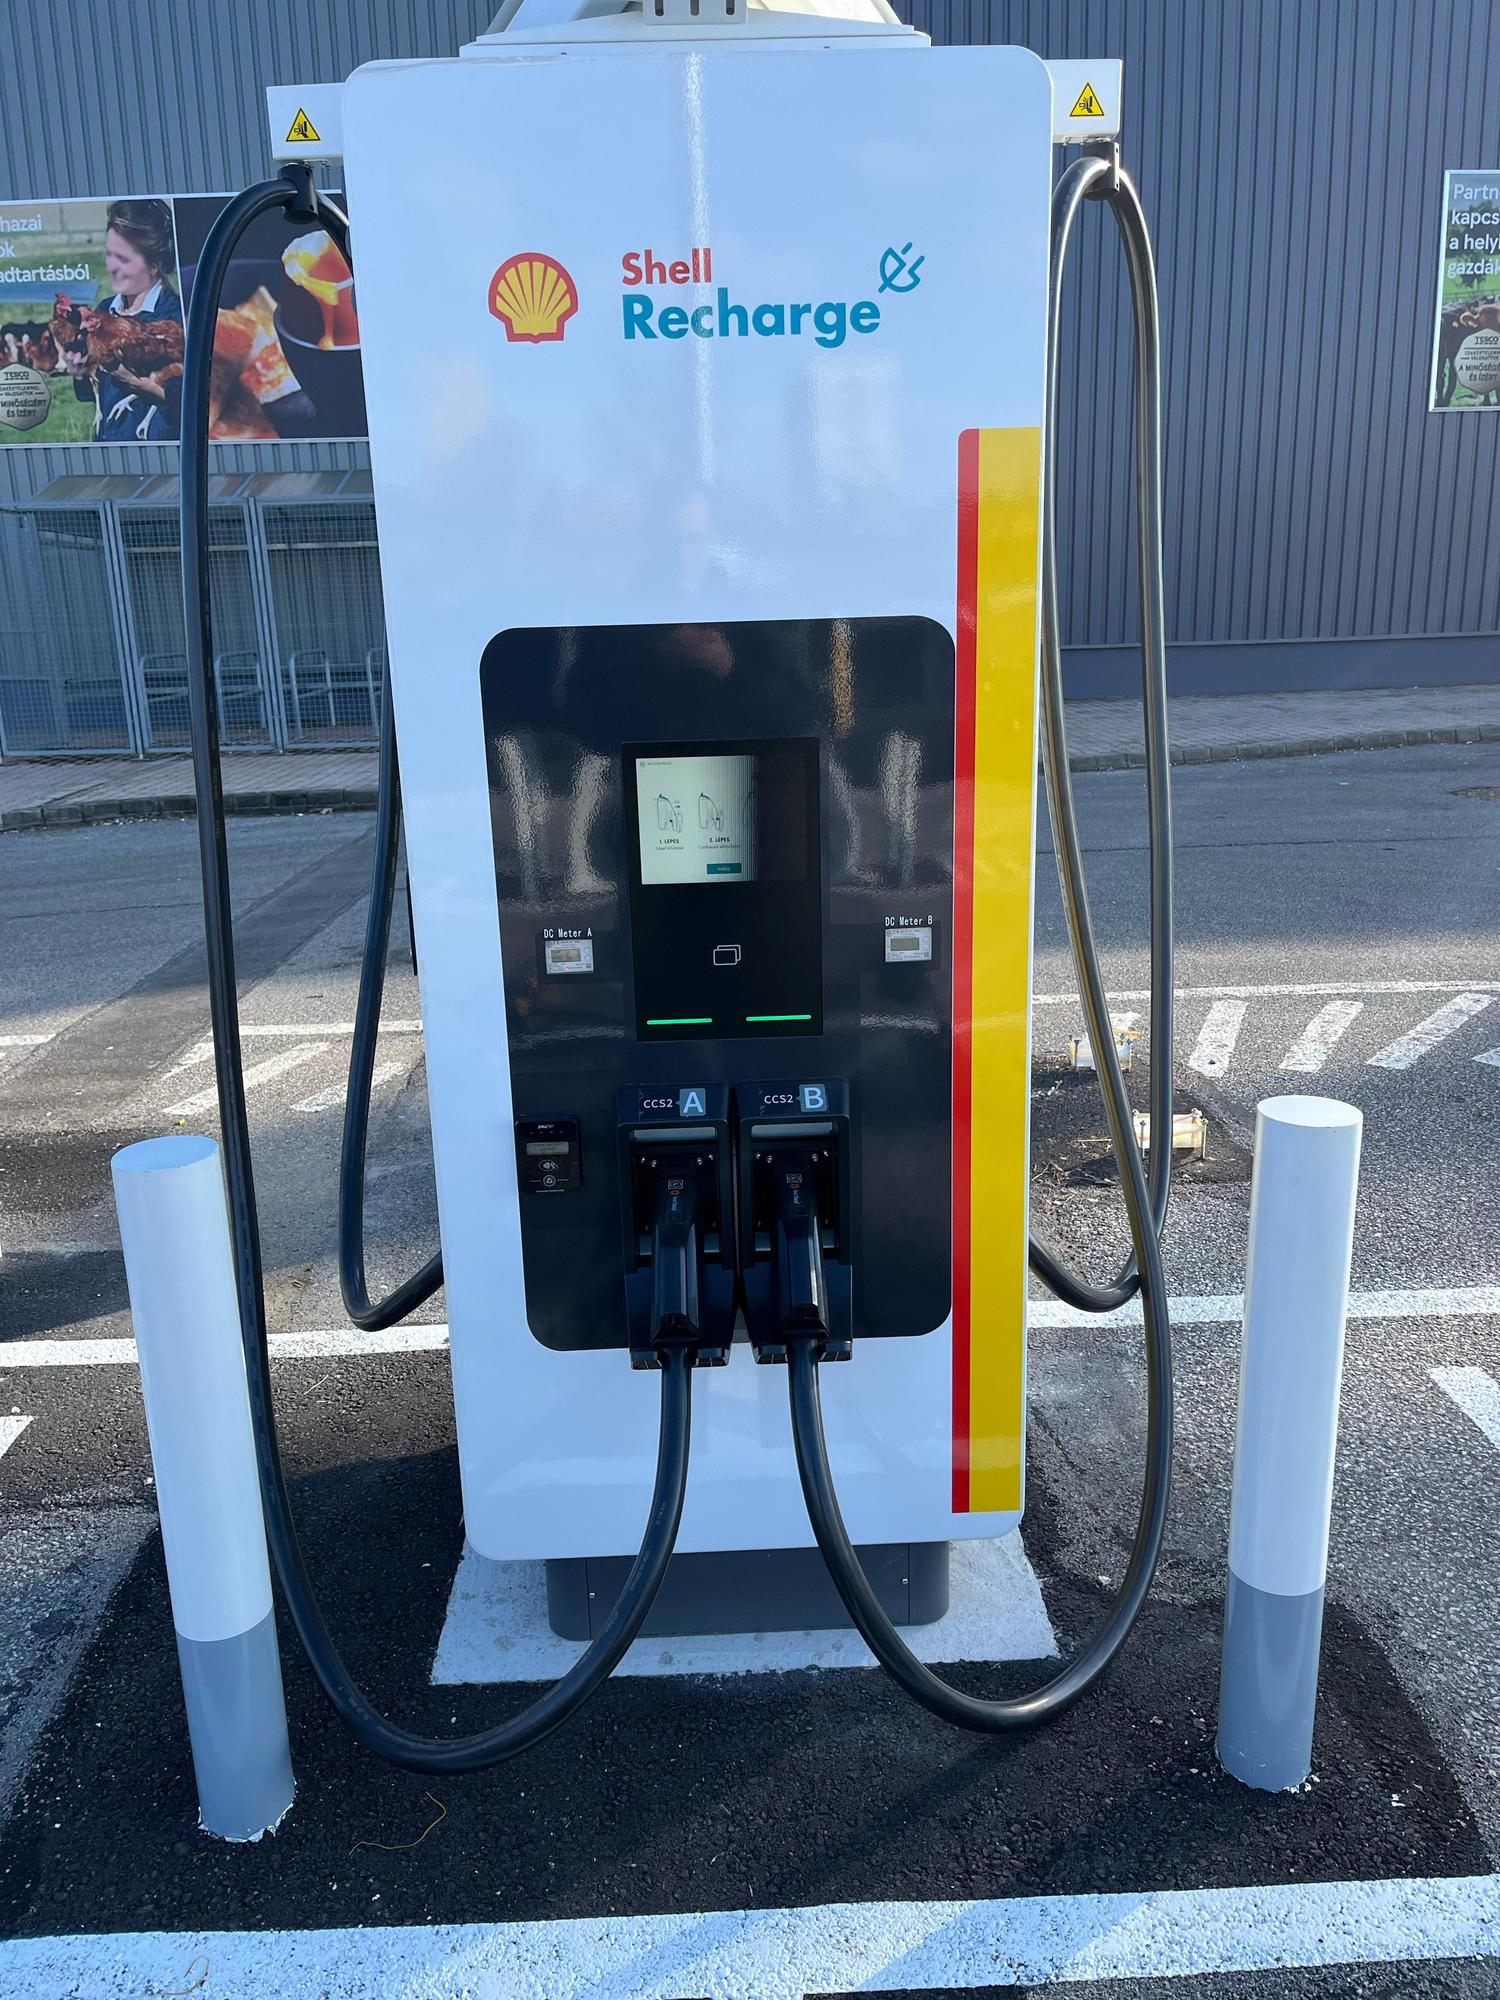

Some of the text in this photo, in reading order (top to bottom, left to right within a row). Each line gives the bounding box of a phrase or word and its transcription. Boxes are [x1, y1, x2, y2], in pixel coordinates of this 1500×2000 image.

[1453, 183, 1500, 200] Partn
[0, 214, 42, 232] hazai
[1451, 209, 1500, 229] kapcs
[1449, 237, 1459, 250] a
[622, 247, 711, 285] Shell
[622, 287, 881, 348] Recharge
[885, 914, 933, 926] DC Meter B
[543, 927, 593, 939] DC Meter A
[643, 1091, 704, 1114] CCS2 A
[764, 1087, 824, 1109] CCS2 B
